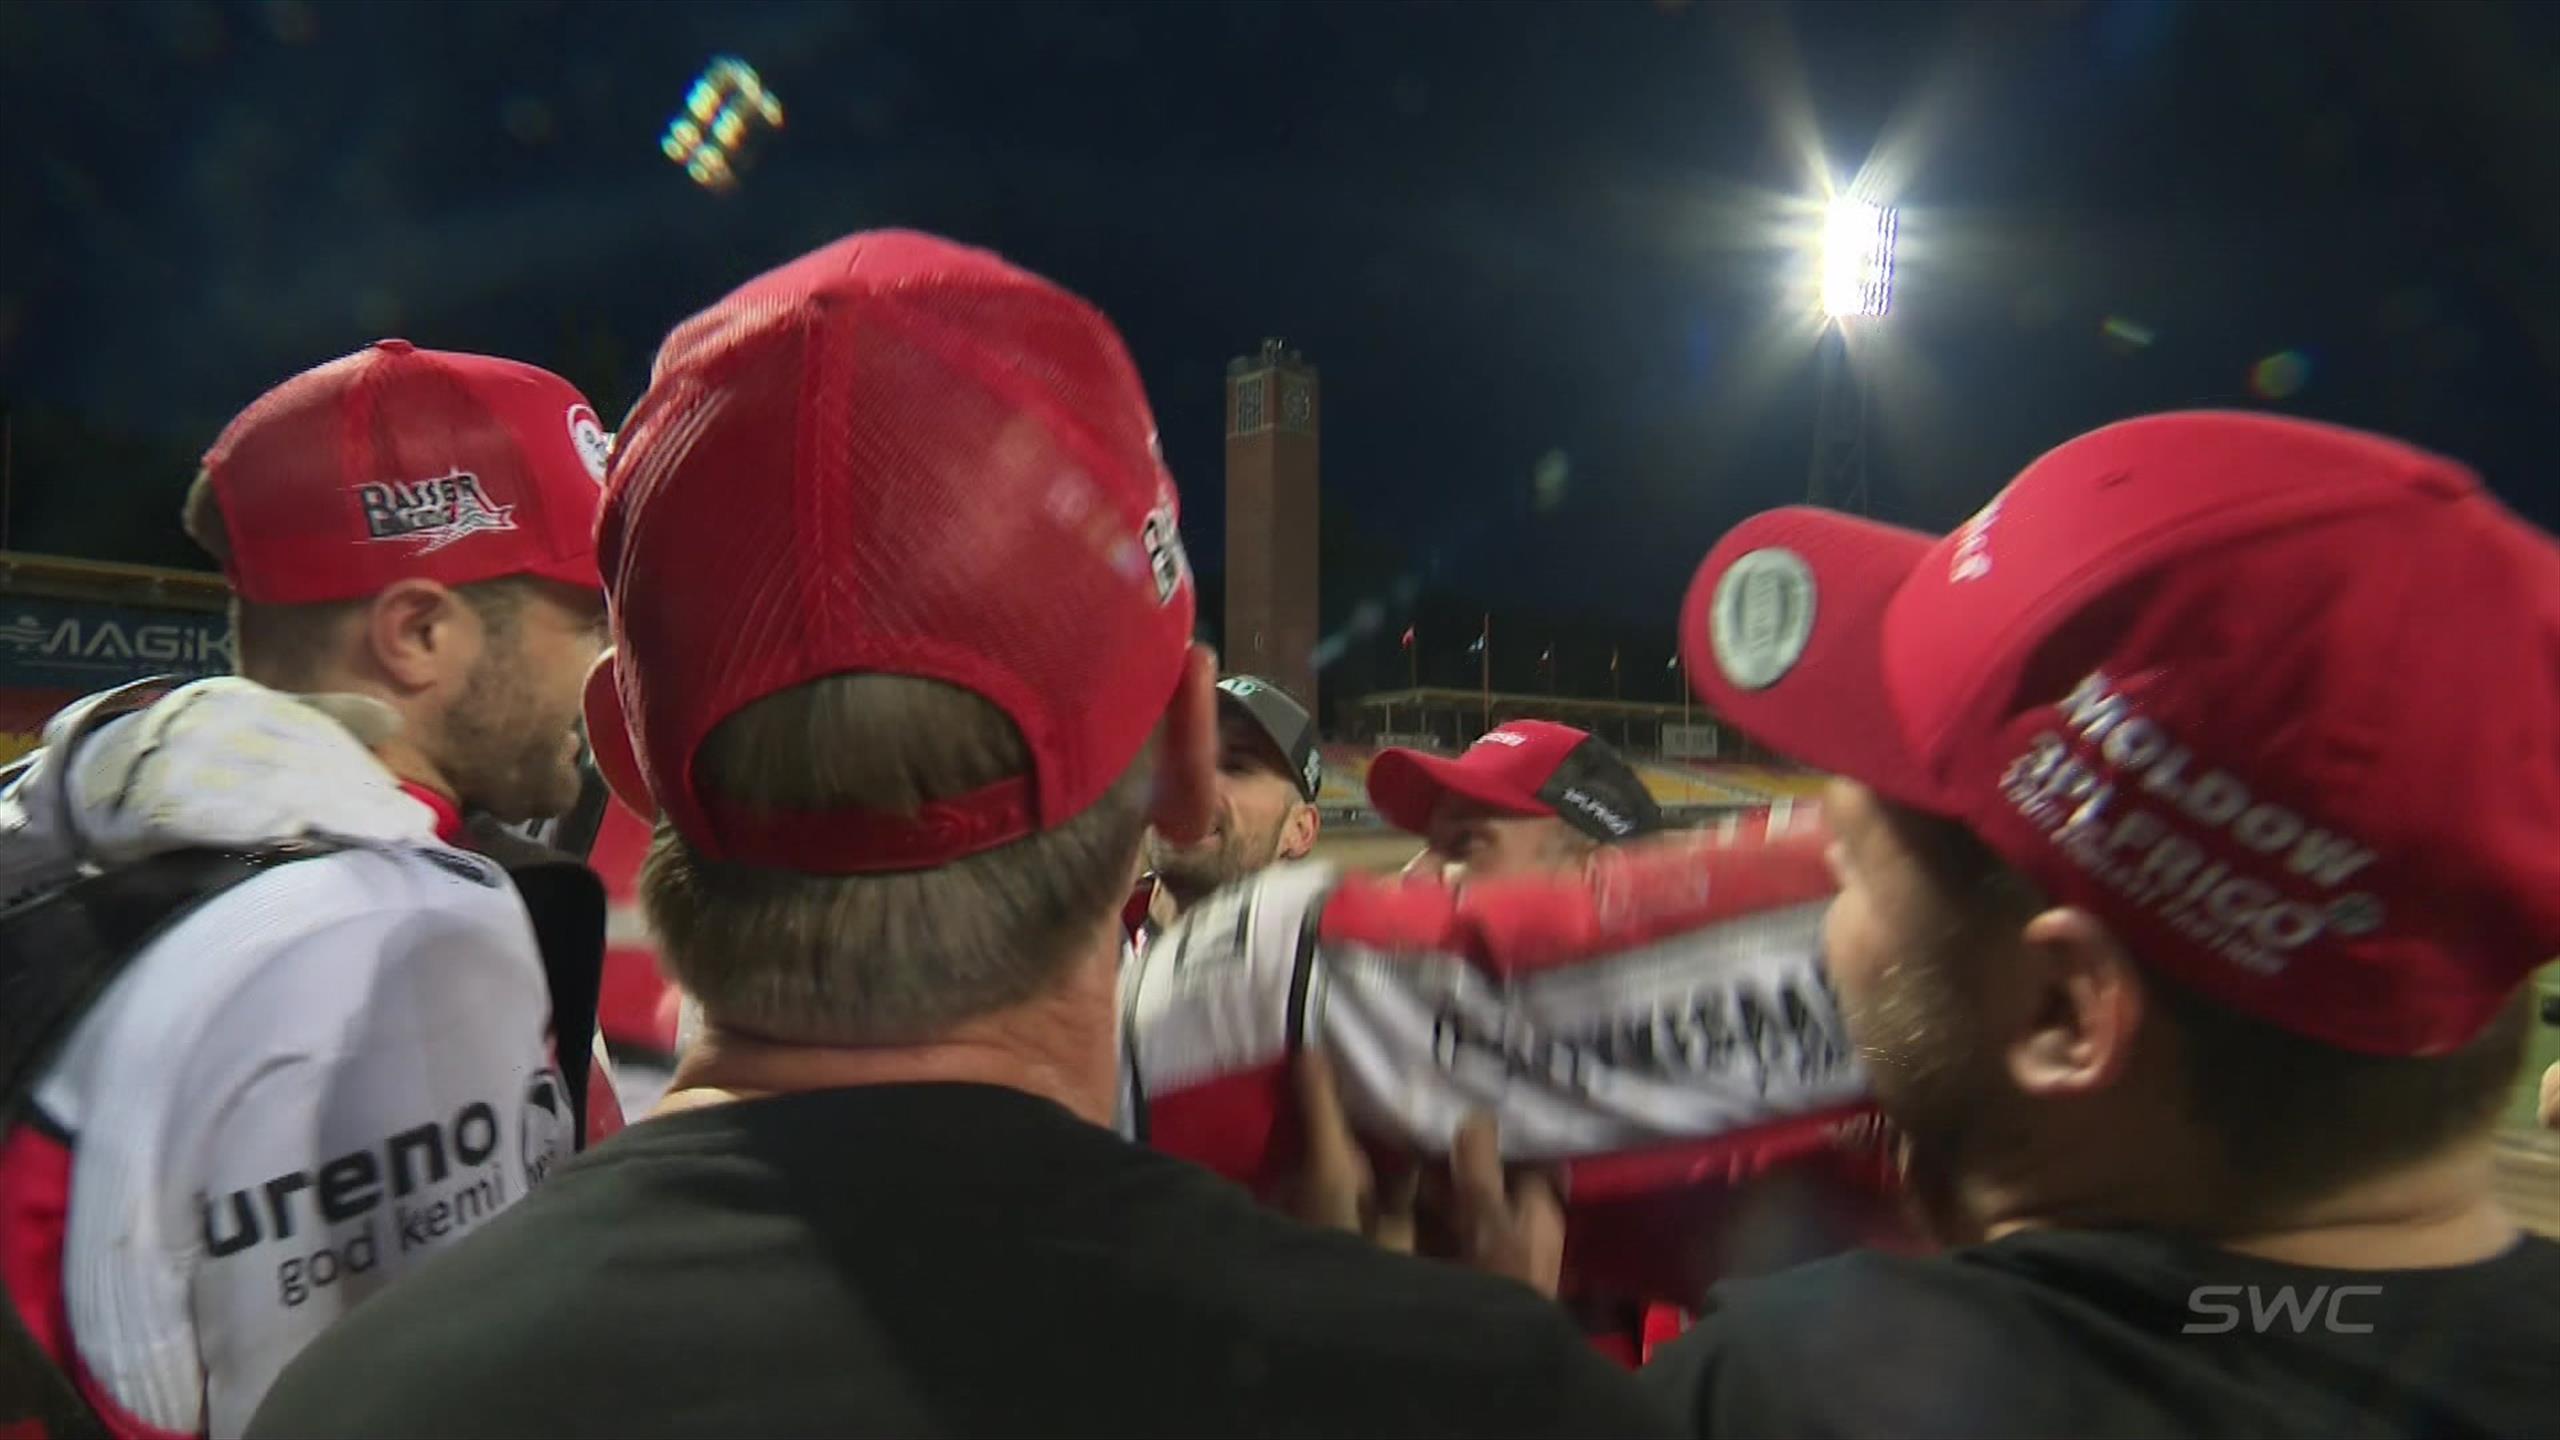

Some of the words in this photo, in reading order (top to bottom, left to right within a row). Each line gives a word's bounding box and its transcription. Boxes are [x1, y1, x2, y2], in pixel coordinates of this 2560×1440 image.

[2055, 669, 2378, 887] MOLDOW
[192, 1101, 497, 1258] ureno
[277, 1218, 379, 1307] god
